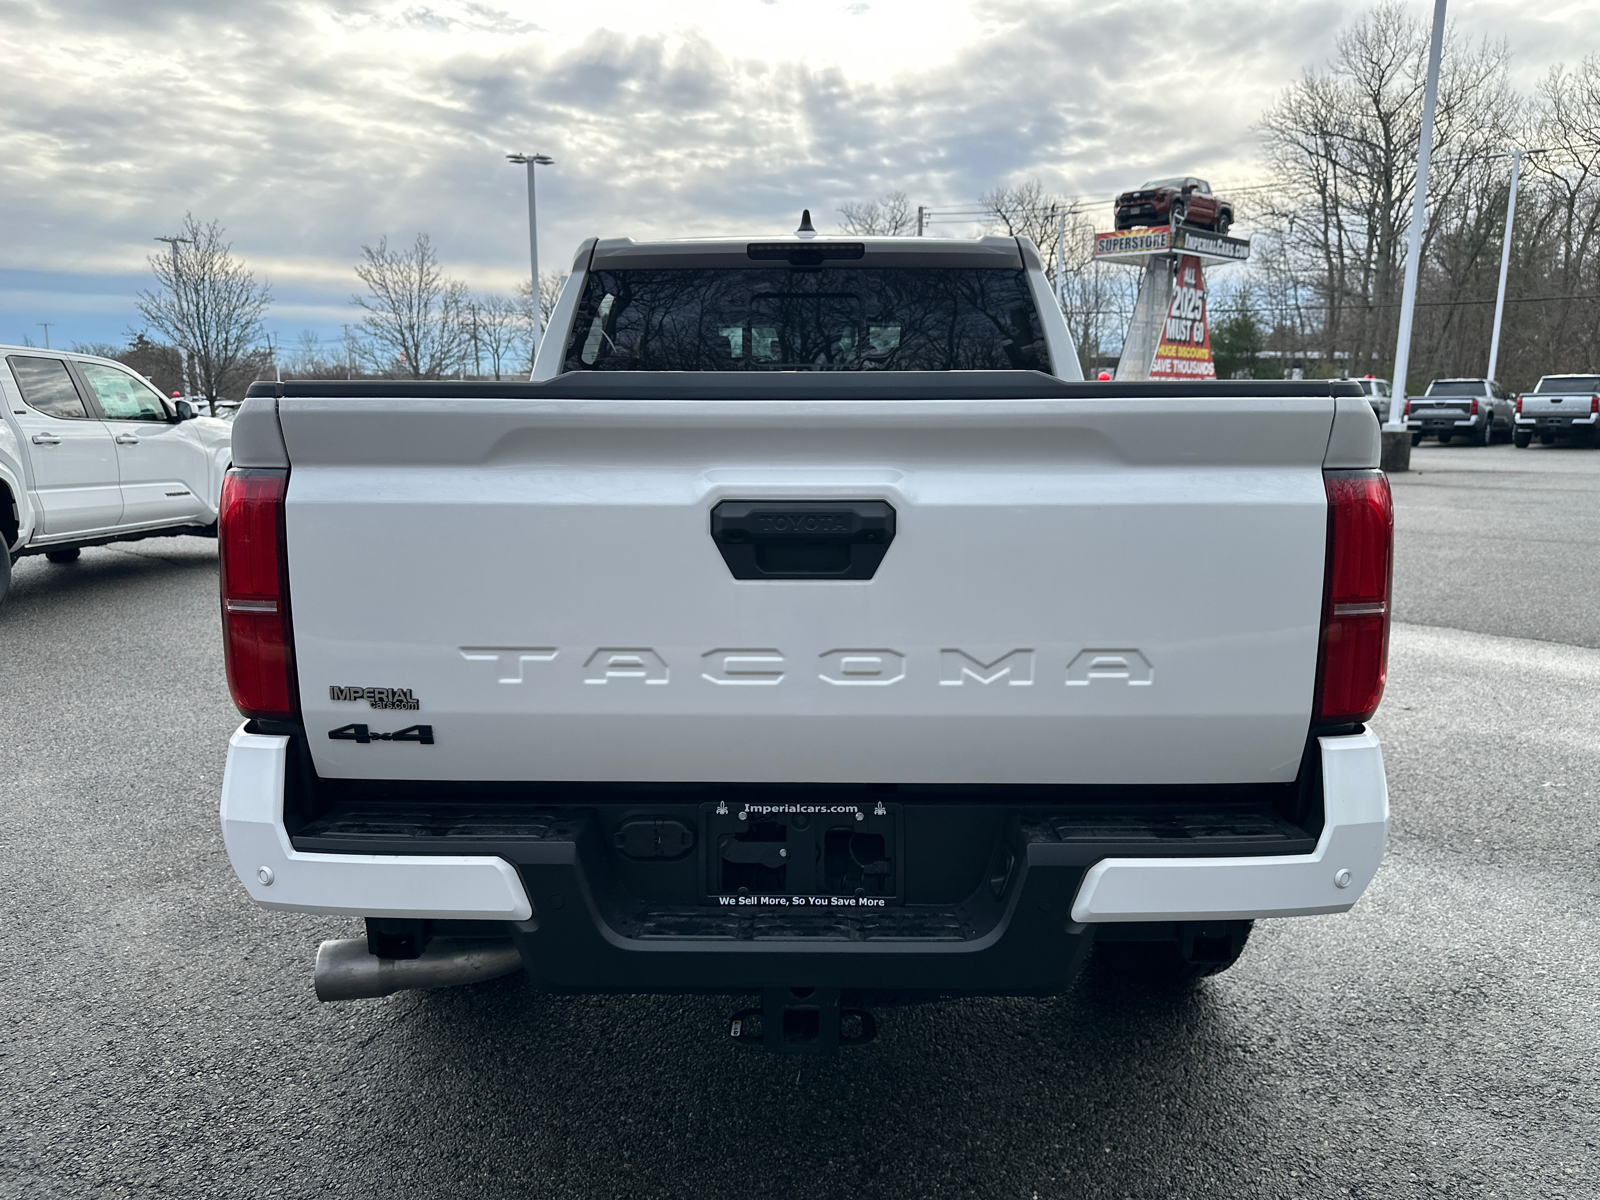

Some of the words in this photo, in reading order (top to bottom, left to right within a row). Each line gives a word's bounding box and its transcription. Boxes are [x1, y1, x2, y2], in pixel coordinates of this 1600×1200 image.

[1099, 234, 1167, 252] SUPERSTORE
[1184, 267, 1196, 284] ALL
[1171, 285, 1203, 320] 2025
[1166, 318, 1192, 342] MUST
[1193, 321, 1205, 343] GO
[1158, 345, 1177, 357] HUGE
[1178, 346, 1209, 360] DISCOUNTS
[1152, 359, 1171, 373] SAVE
[1173, 360, 1215, 376] THOUSANDS
[760, 515, 848, 531] TOYOTA
[458, 646, 1154, 687] TACOMA
[329, 686, 419, 702] IMPERIAL
[370, 700, 419, 710] cars.com
[328, 723, 434, 744] 4x4
[744, 803, 858, 815] Imperialcars.com
[719, 897, 736, 906] We
[738, 896, 758, 905] Sell
[760, 897, 790, 907] More,
[792, 897, 806, 906] So
[808, 897, 828, 906] You
[830, 897, 856, 906] Save
[858, 897, 885, 907] More
